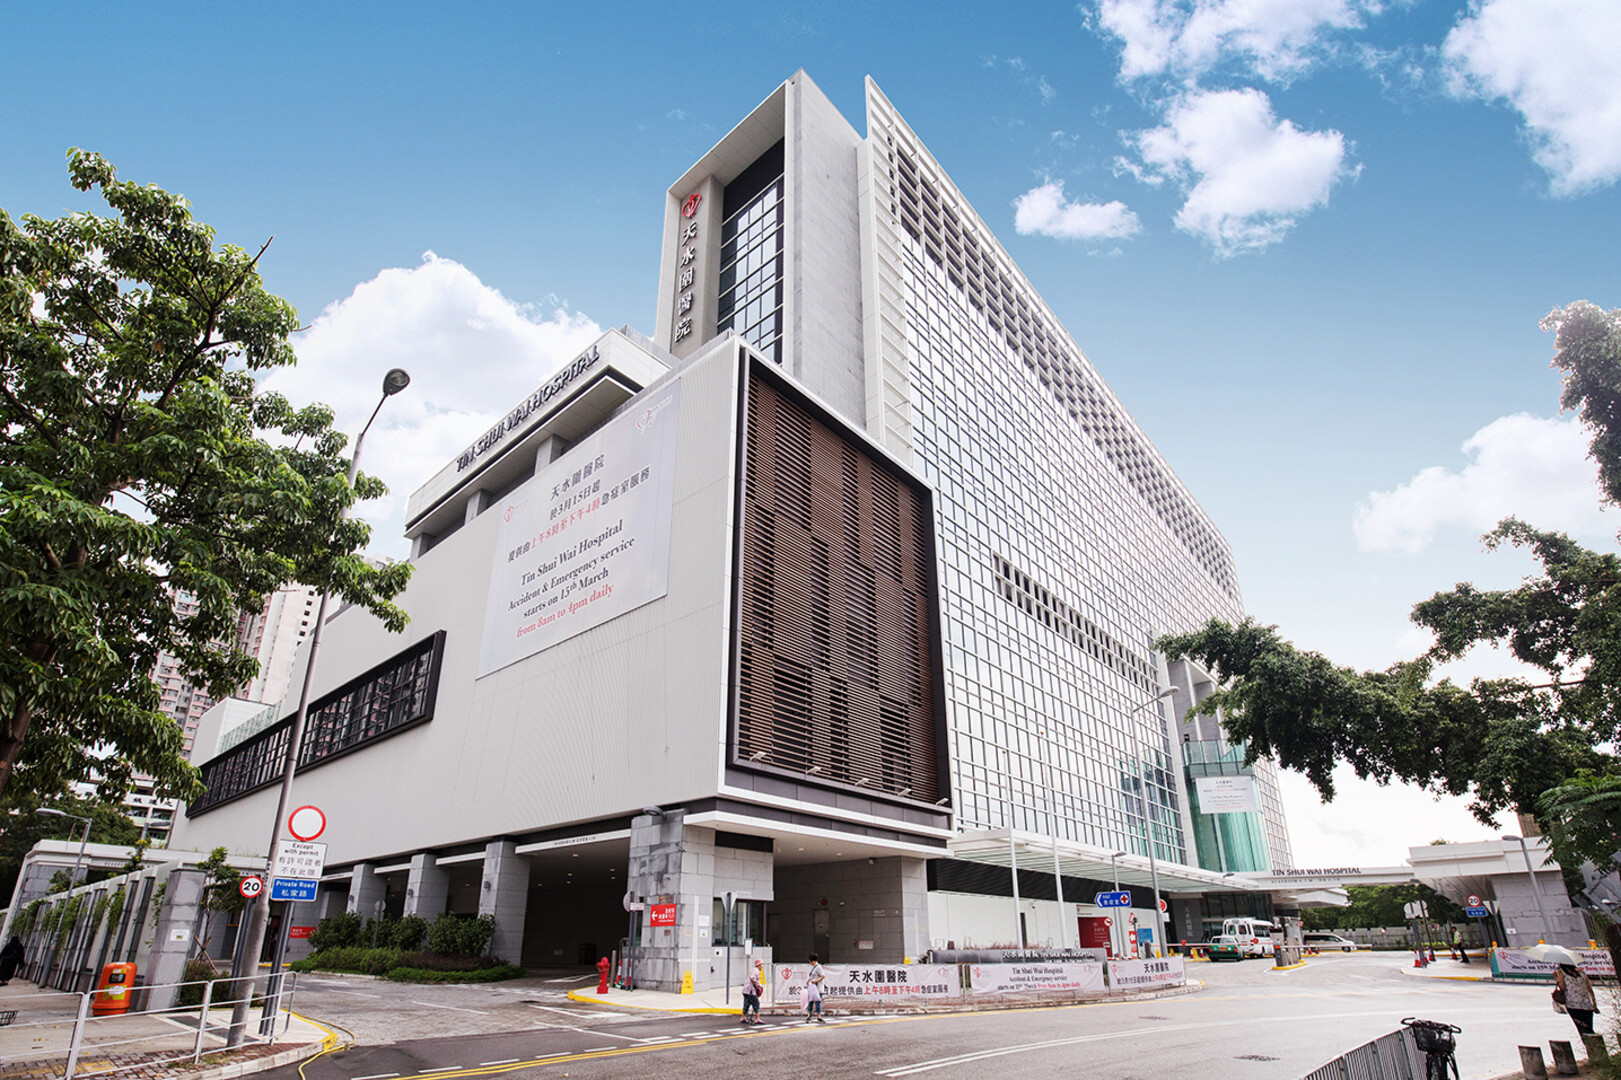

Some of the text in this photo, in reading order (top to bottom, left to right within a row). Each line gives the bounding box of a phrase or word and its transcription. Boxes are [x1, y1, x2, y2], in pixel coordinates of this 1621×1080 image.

[675, 221, 697, 343] 天水圍醫院
[457, 345, 600, 472] TIN SHUI WAI HOSPITAL
[549, 479, 601, 520] 於3月15日起
[550, 454, 604, 501] 天水圍醫院
[508, 538, 635, 611] Accident & Emergency service
[521, 519, 623, 586] Tin Shui Wai Hospital
[516, 583, 614, 638] from 8am to 4pm daily
[523, 567, 609, 618] starts on 15th March
[243, 882, 260, 892] 20
[276, 880, 315, 889] Private Road
[281, 889, 307, 898] 私家路
[1286, 868, 1305, 876] SHUI
[1323, 867, 1361, 875] HOSPITAL
[849, 970, 908, 983] 天水圍醫院
[1012, 967, 1020, 975] Tin
[1044, 966, 1063, 976] Hospital
